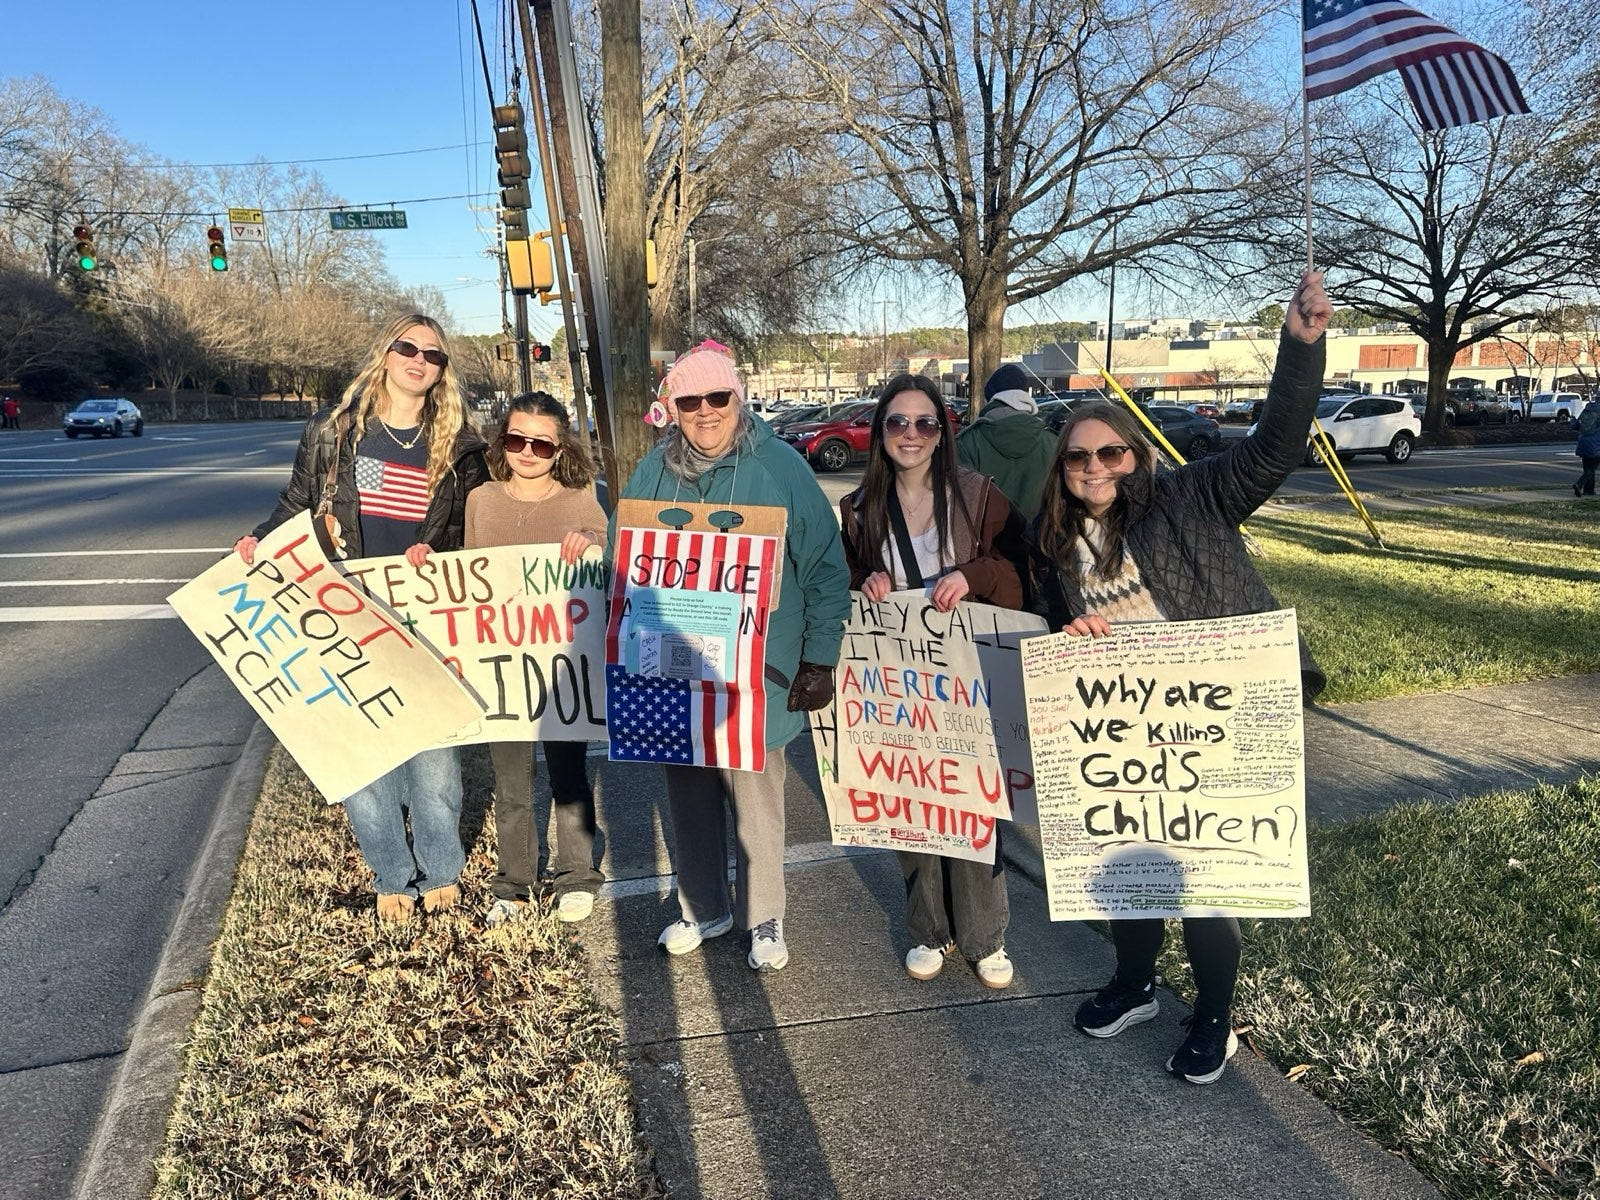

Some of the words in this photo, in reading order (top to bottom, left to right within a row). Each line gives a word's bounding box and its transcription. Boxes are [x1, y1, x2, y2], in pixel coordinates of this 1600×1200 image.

[347, 213, 358, 228] S.
[360, 213, 394, 228] Elliott
[1140, 377, 1160, 386] CAVA
[273, 534, 414, 649] HOT
[522, 556, 605, 595] KNOWS
[630, 554, 700, 589] STOP
[715, 560, 760, 594] ICE
[218, 583, 352, 707] MELT
[246, 560, 404, 729] PEOPLE
[430, 598, 590, 648] TRUMP
[920, 604, 1019, 652] CALL
[205, 614, 292, 714] ICE
[844, 631, 887, 662] IT
[891, 637, 949, 667] THE
[479, 652, 607, 726] IDOL
[842, 665, 992, 709] AMERICAN
[1075, 673, 1156, 714] Why
[1164, 680, 1233, 711] are
[845, 700, 938, 733] DREAM
[942, 711, 999, 738] BECAUSE
[846, 730, 859, 744] TO
[863, 731, 875, 745] BE
[881, 732, 915, 748] ASLEEP
[919, 736, 932, 750] TO
[936, 736, 977, 754] BELIEVE
[987, 743, 1006, 759] IT
[857, 746, 968, 796] WAKE
[976, 764, 1035, 812] UP
